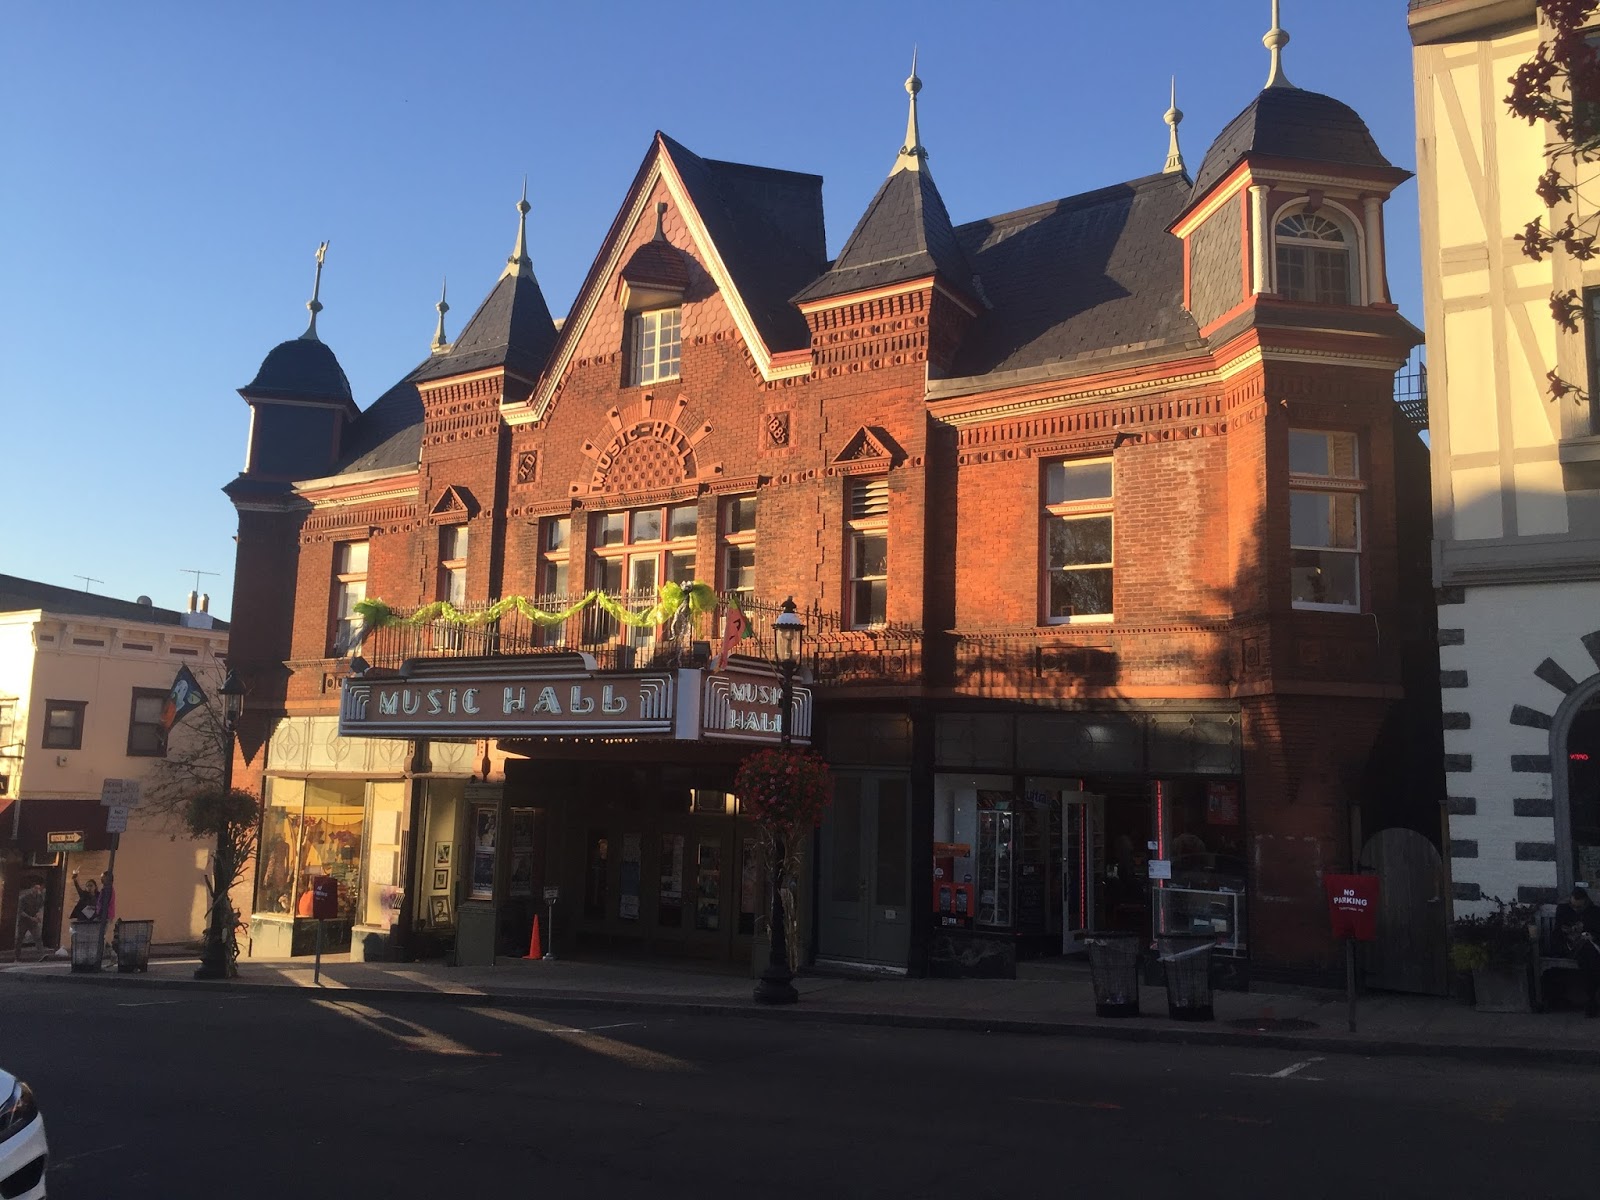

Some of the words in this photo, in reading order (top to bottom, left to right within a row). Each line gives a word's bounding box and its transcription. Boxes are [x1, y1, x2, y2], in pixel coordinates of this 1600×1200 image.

[768, 417, 786, 444] 1885
[379, 688, 480, 716] MUSIC
[502, 685, 628, 715] HALL
[1333, 896, 1368, 907] PARKING
[1343, 889, 1355, 897] NO
